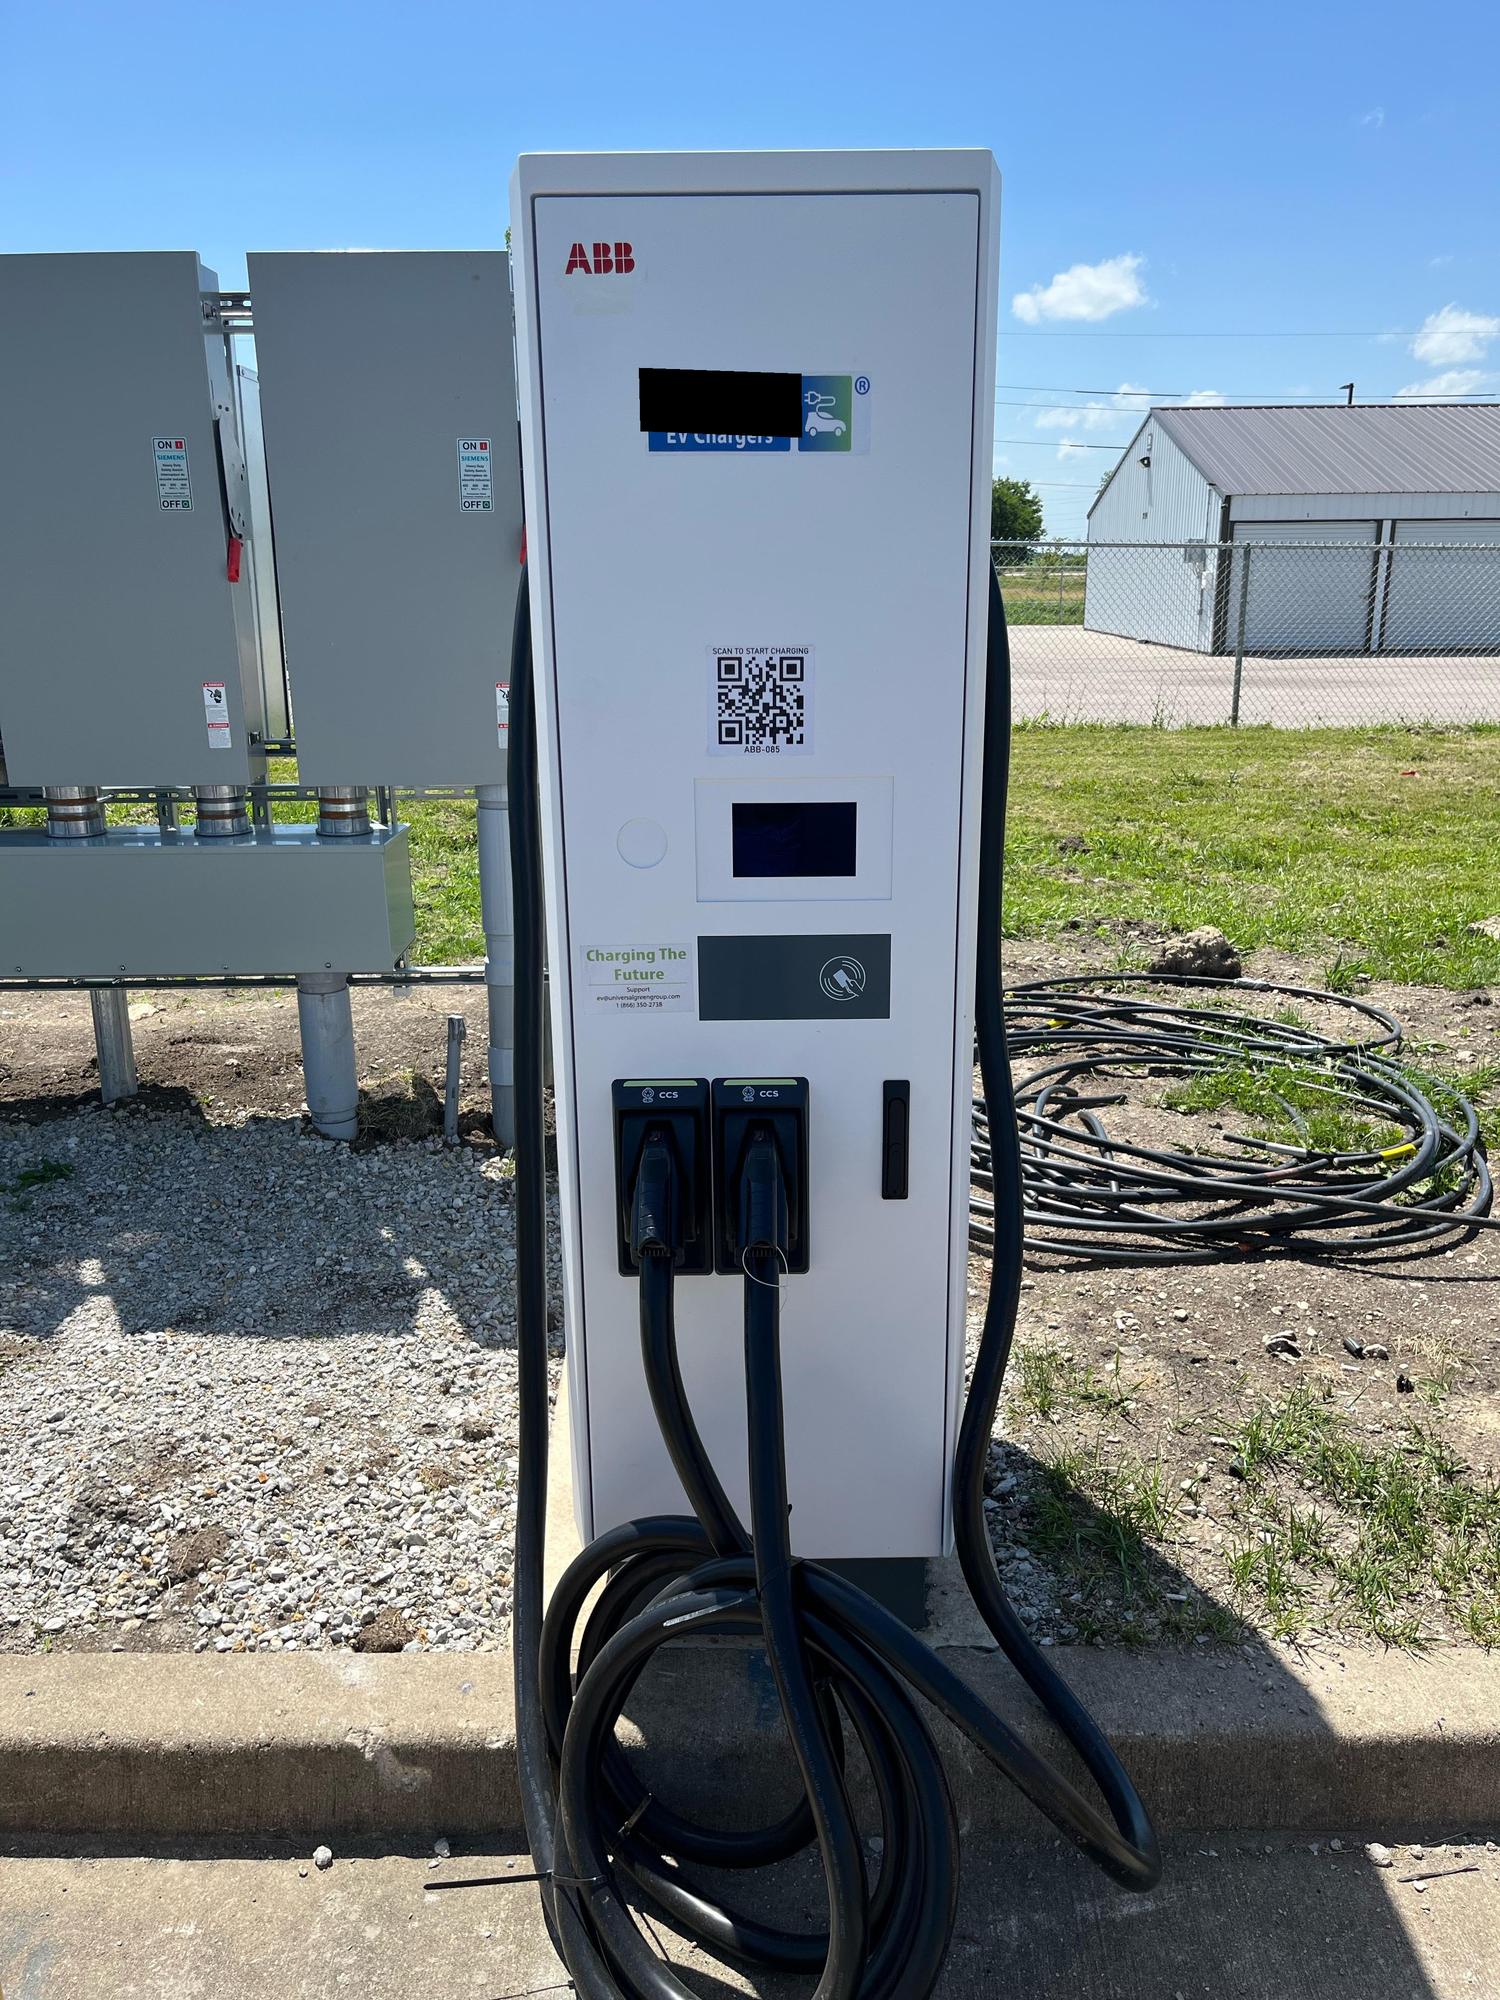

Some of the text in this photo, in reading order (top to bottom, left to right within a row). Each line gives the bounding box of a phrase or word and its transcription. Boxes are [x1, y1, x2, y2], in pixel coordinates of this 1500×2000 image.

[565, 242, 635, 275] ABB
[157, 441, 172, 449] ON
[462, 442, 477, 450] ON
[712, 647, 809, 655] SCAN TO START CHARGING
[744, 745, 780, 754] ABB-085
[586, 947, 687, 964] Charging The
[614, 968, 665, 981] Future
[658, 1091, 679, 1099] CCS
[759, 1090, 779, 1098] CCS
